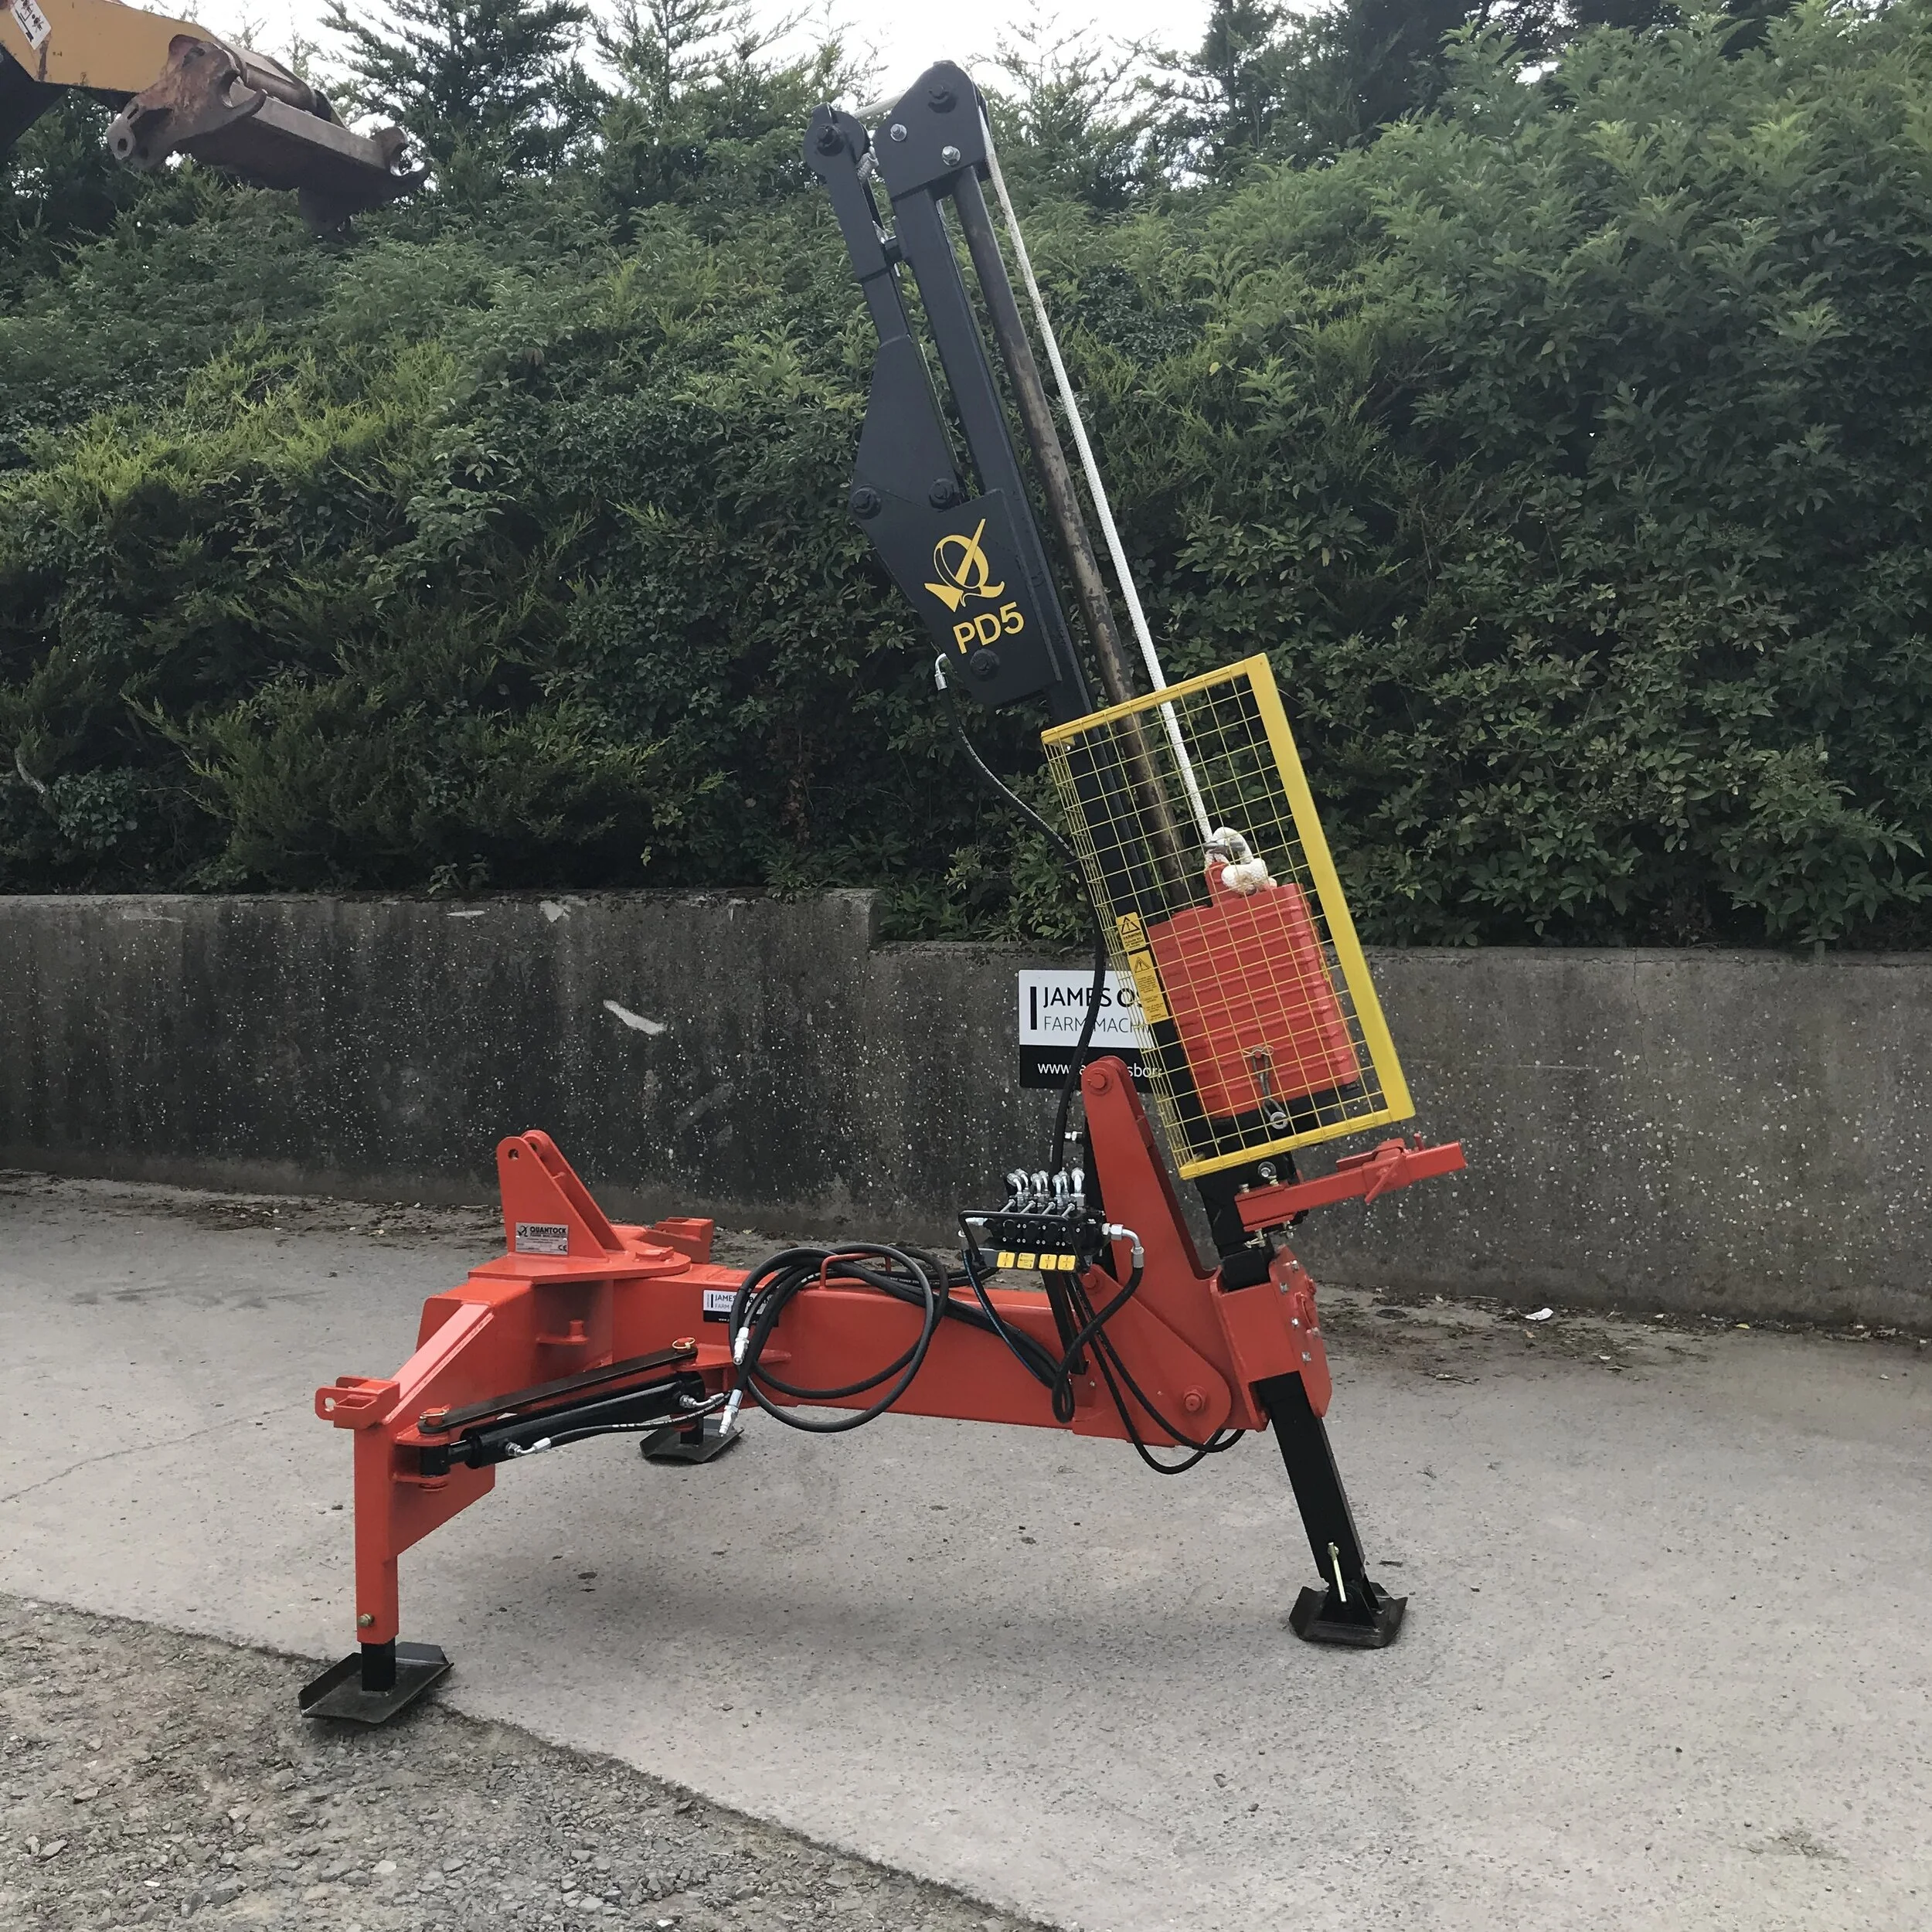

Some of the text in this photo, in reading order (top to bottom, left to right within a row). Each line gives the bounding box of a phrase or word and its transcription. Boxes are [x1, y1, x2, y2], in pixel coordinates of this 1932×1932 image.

[953, 601, 1024, 654] PD5
[1043, 987, 1112, 1008] JAMES
[1044, 1016, 1087, 1031] FARM
